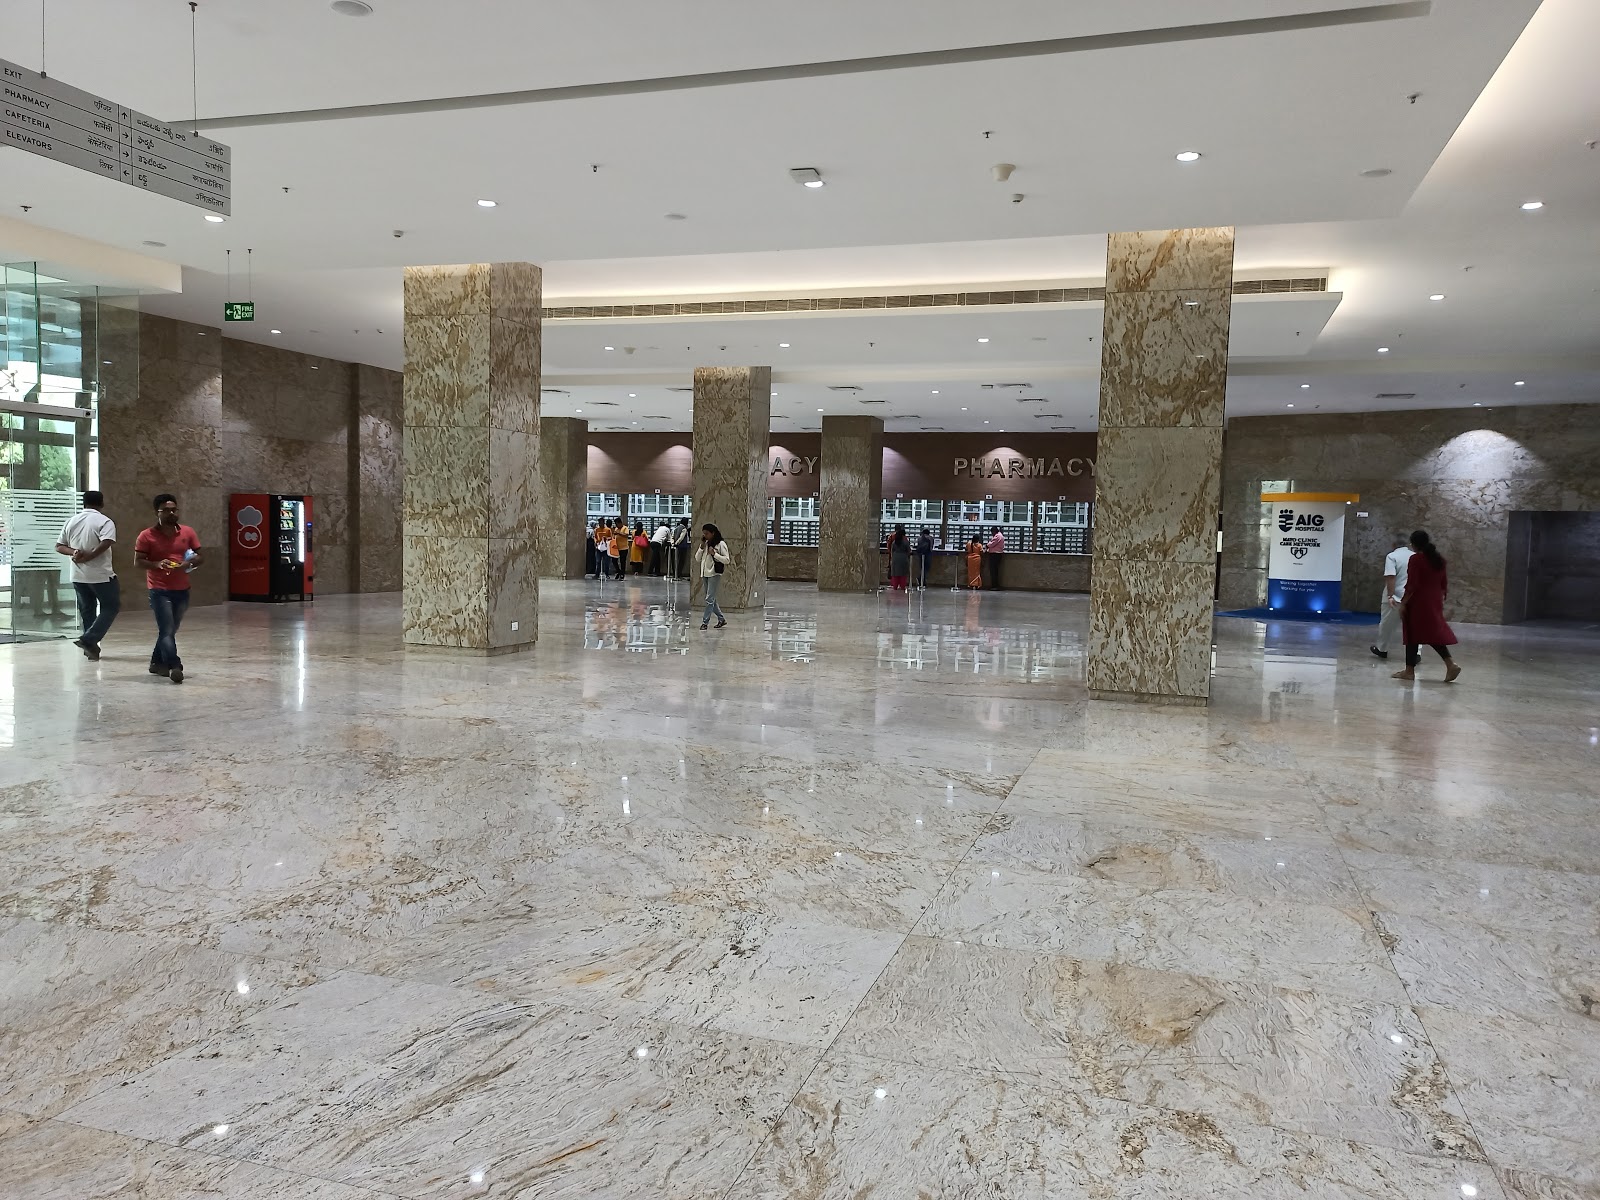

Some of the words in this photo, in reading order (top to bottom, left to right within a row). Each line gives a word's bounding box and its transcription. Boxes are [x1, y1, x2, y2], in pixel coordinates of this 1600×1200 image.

[4, 67, 23, 80] EXIT
[4, 88, 50, 109] PHARMACY
[5, 108, 51, 131] CAFETERIA
[6, 129, 53, 151] ELEVATORS
[771, 456, 819, 476] ACY
[953, 457, 1098, 479] PHARMACY
[1295, 514, 1325, 527] AIG
